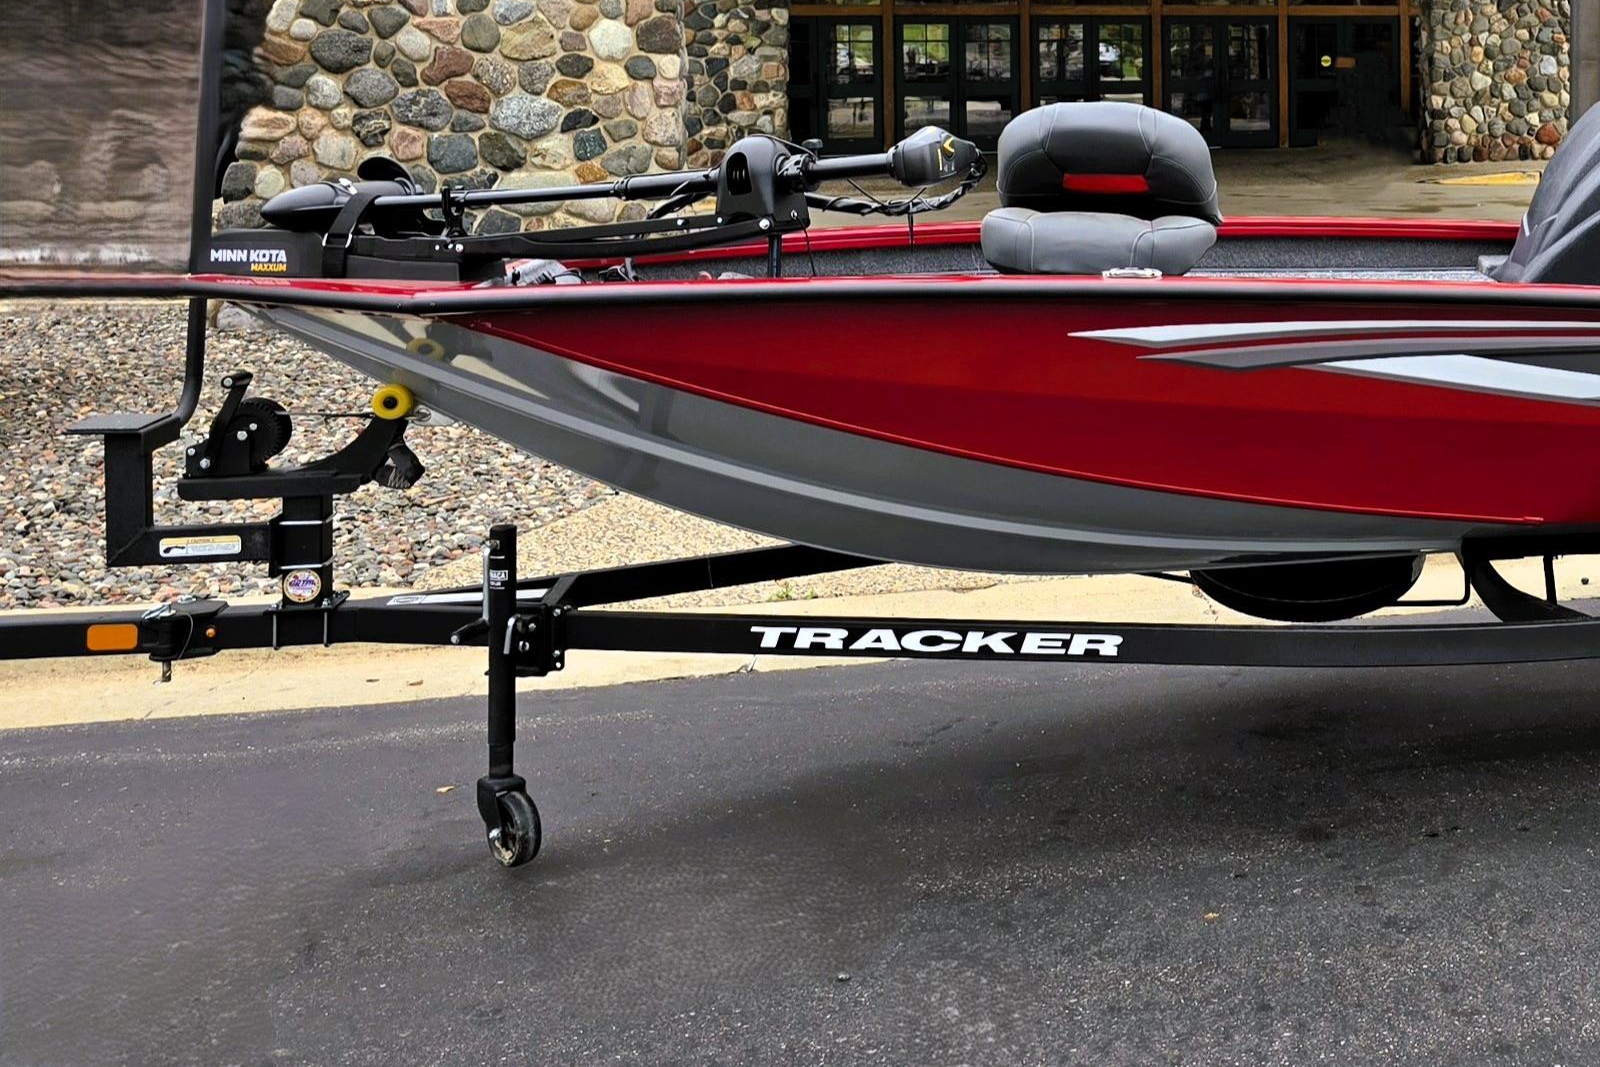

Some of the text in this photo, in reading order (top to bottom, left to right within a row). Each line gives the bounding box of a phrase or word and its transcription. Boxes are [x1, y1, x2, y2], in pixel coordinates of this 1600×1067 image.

[210, 248, 287, 262] MINN KOTA
[250, 263, 287, 272] MAXXUM
[751, 626, 1124, 656] TRACKER
